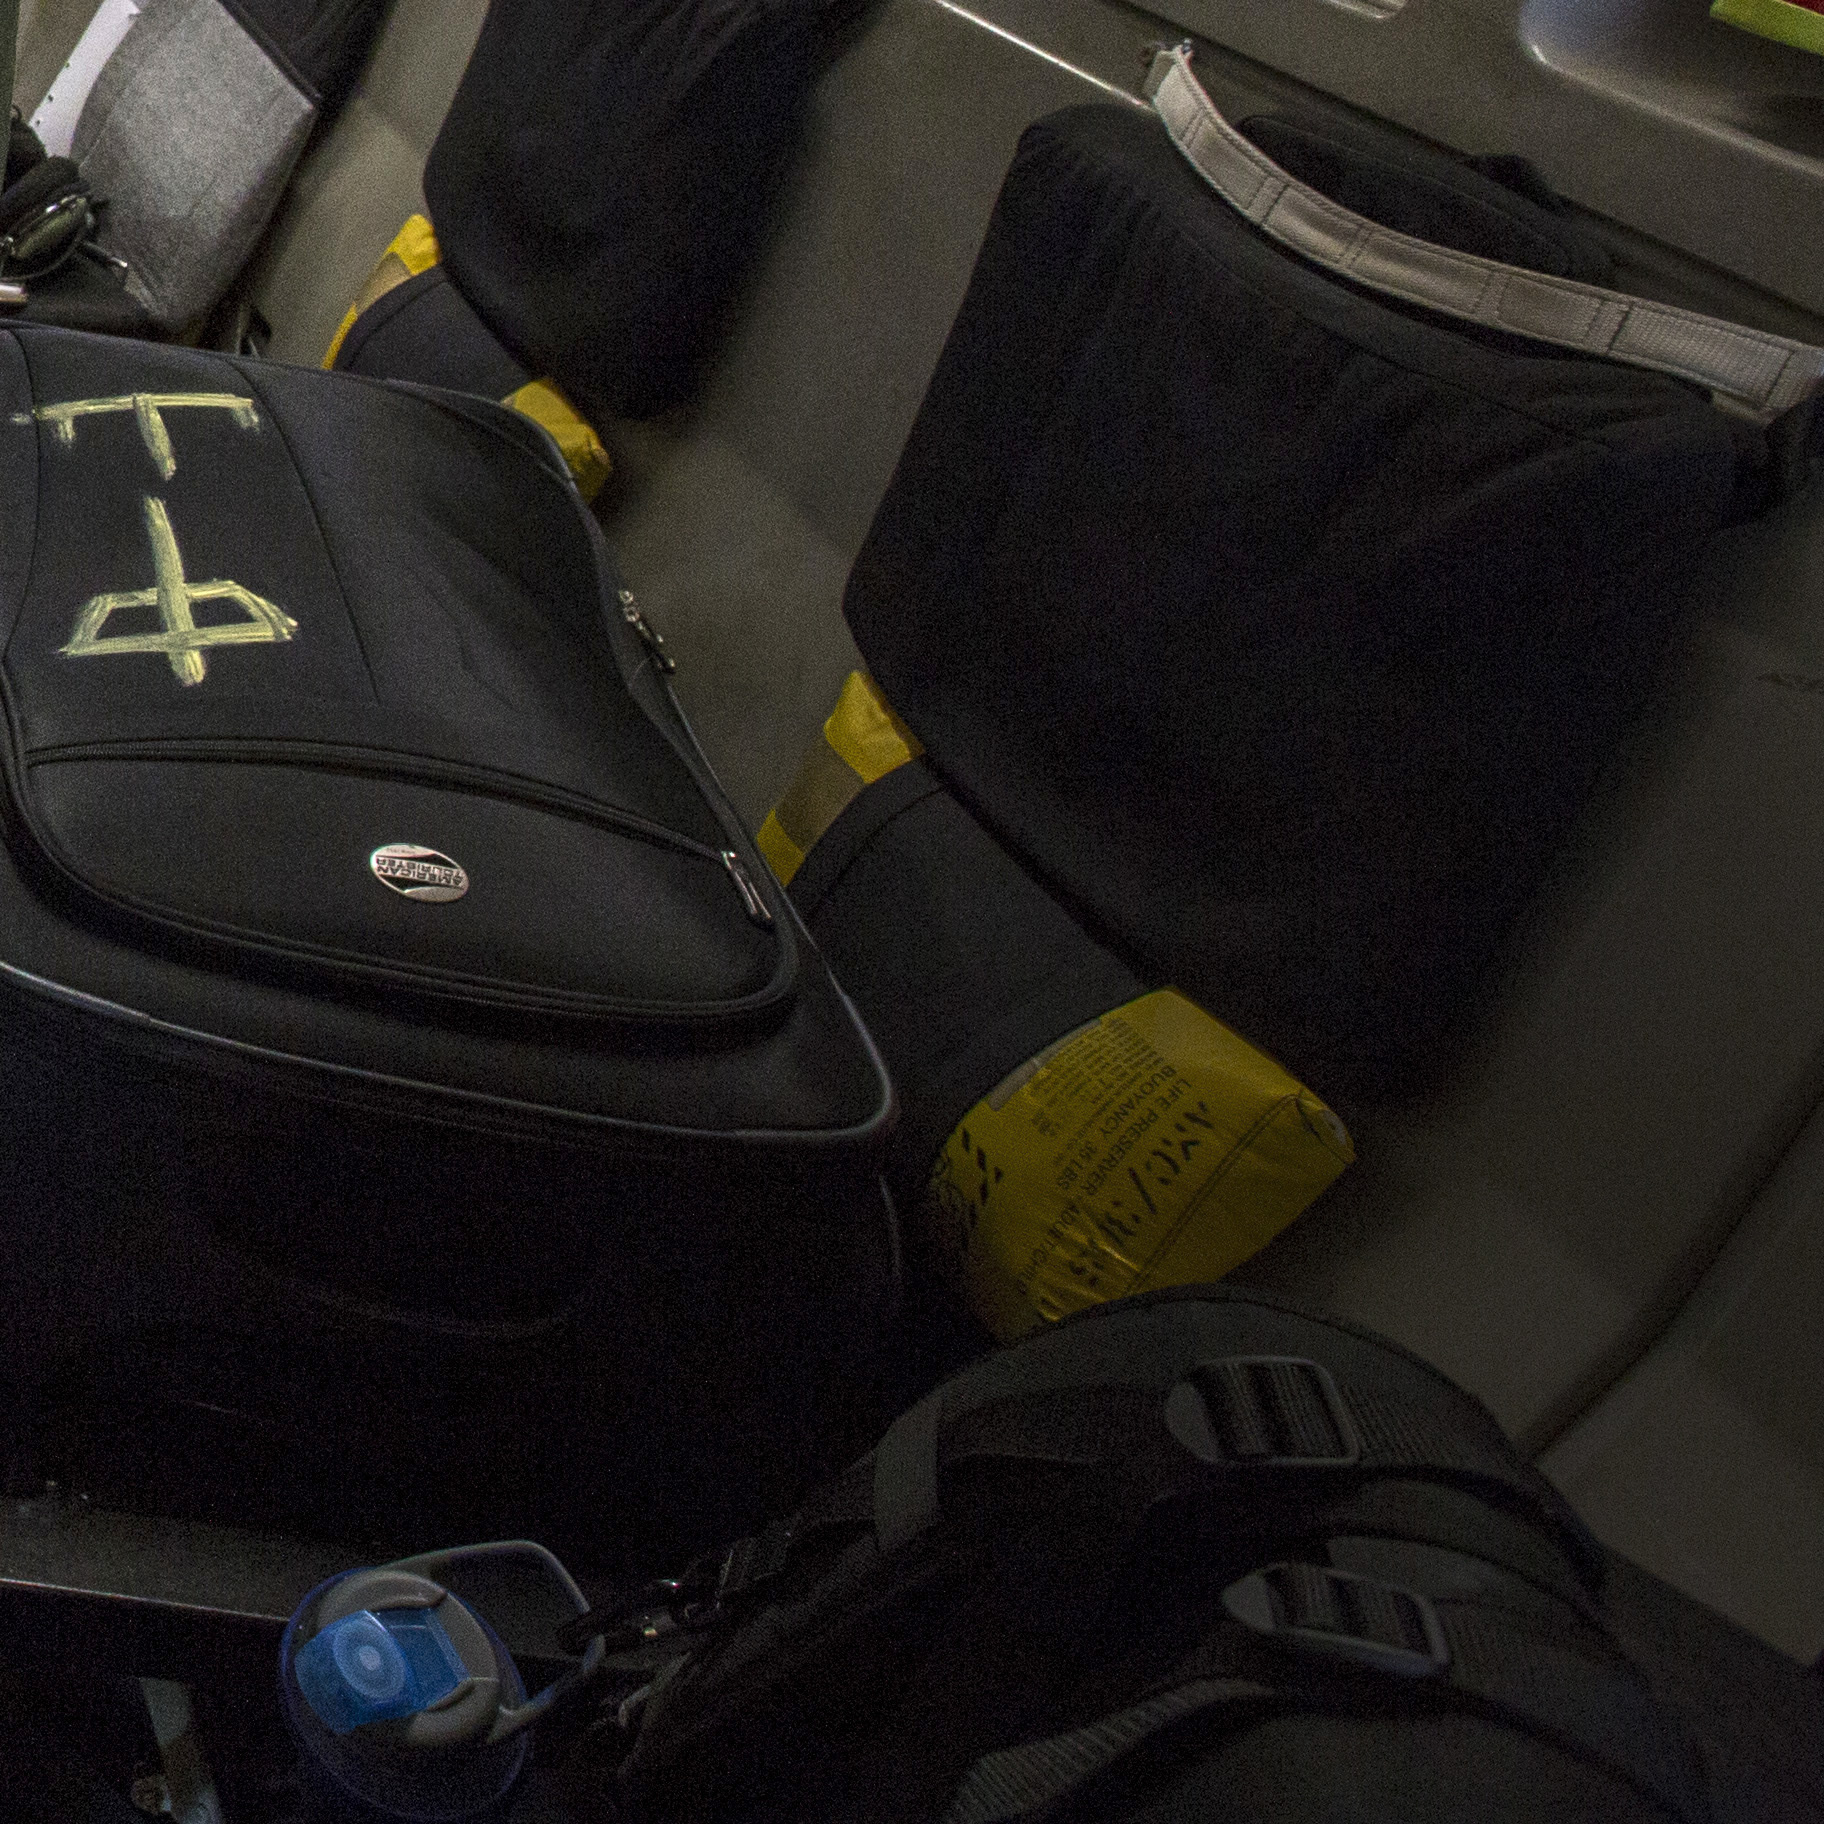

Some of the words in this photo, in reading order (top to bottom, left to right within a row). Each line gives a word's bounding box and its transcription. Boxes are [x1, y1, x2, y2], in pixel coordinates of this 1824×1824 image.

[376, 857, 462, 878] TOURISTER
[376, 864, 464, 887] AMERICAN
[1096, 1062, 1176, 1138] BUOYANCY
[1155, 1077, 1191, 1110] LIFE
[1080, 1109, 1159, 1197] PRESERVER
[1053, 1158, 1084, 1191] LBS
